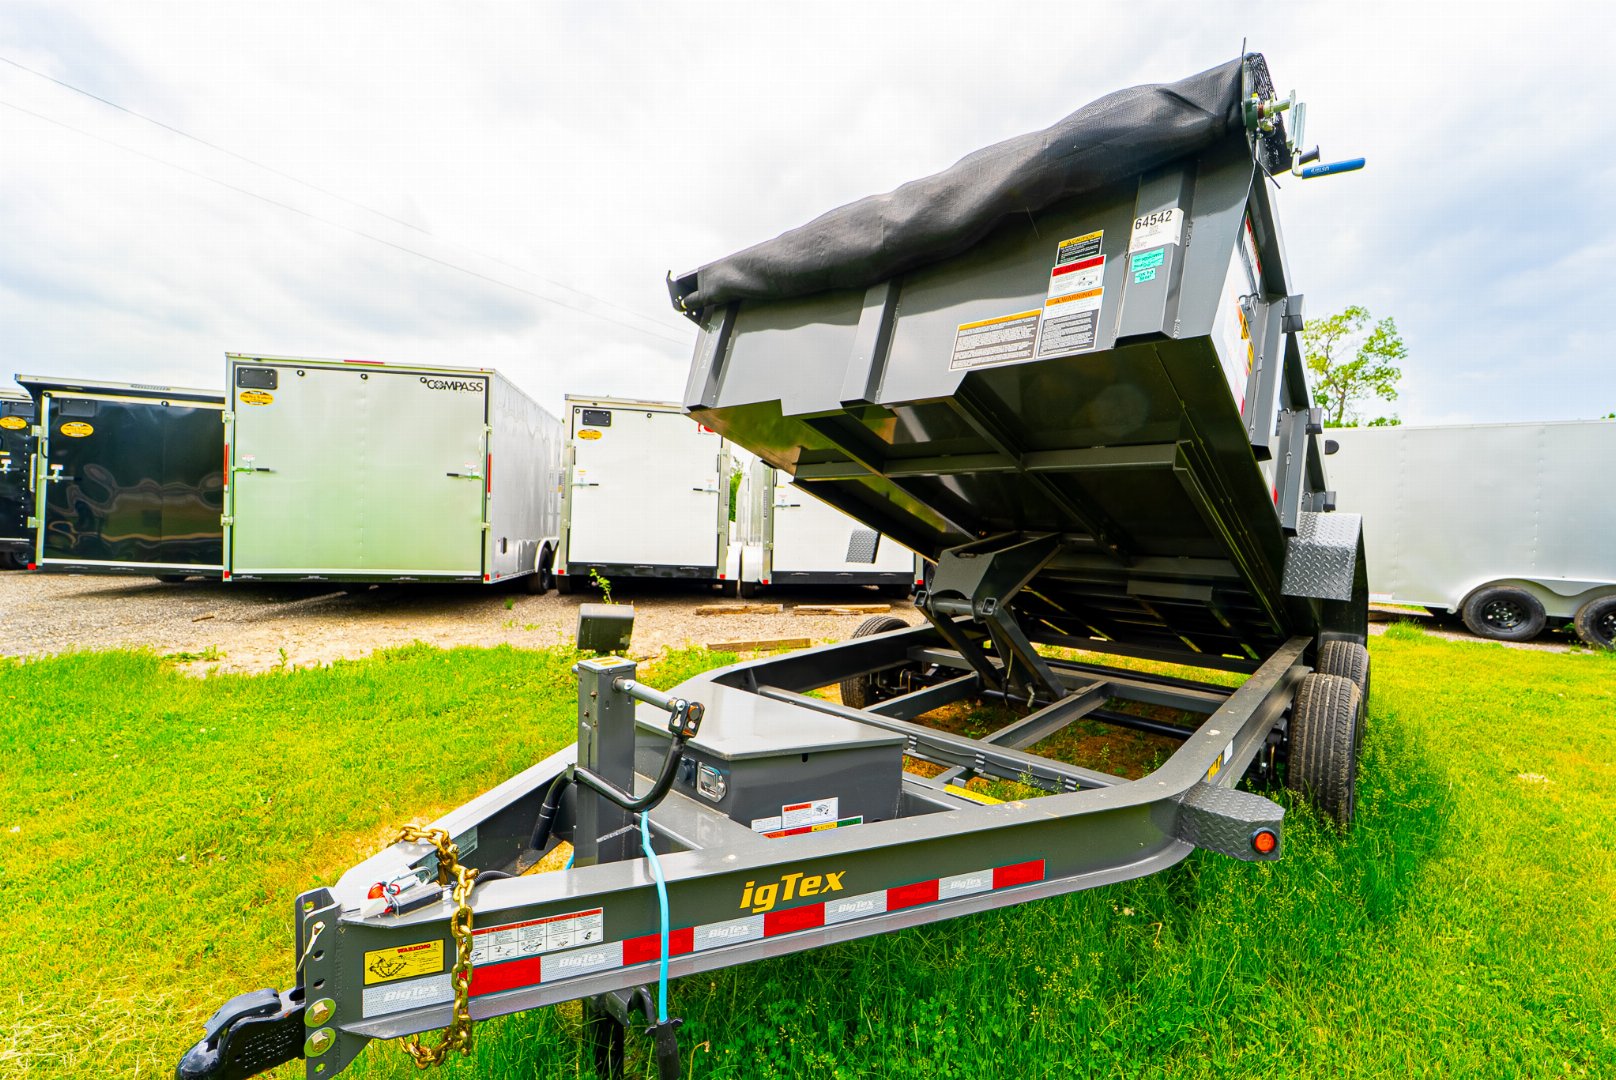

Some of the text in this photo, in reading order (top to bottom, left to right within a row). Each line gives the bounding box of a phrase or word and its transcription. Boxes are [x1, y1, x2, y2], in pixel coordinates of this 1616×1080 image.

[1135, 210, 1173, 230] 64542
[1060, 291, 1093, 303] WARNING
[427, 379, 483, 392] COMPASS
[739, 870, 847, 914] igTex
[838, 899, 874, 913] BigTex
[708, 924, 751, 939] BigTex
[396, 943, 431, 954] WARNING
